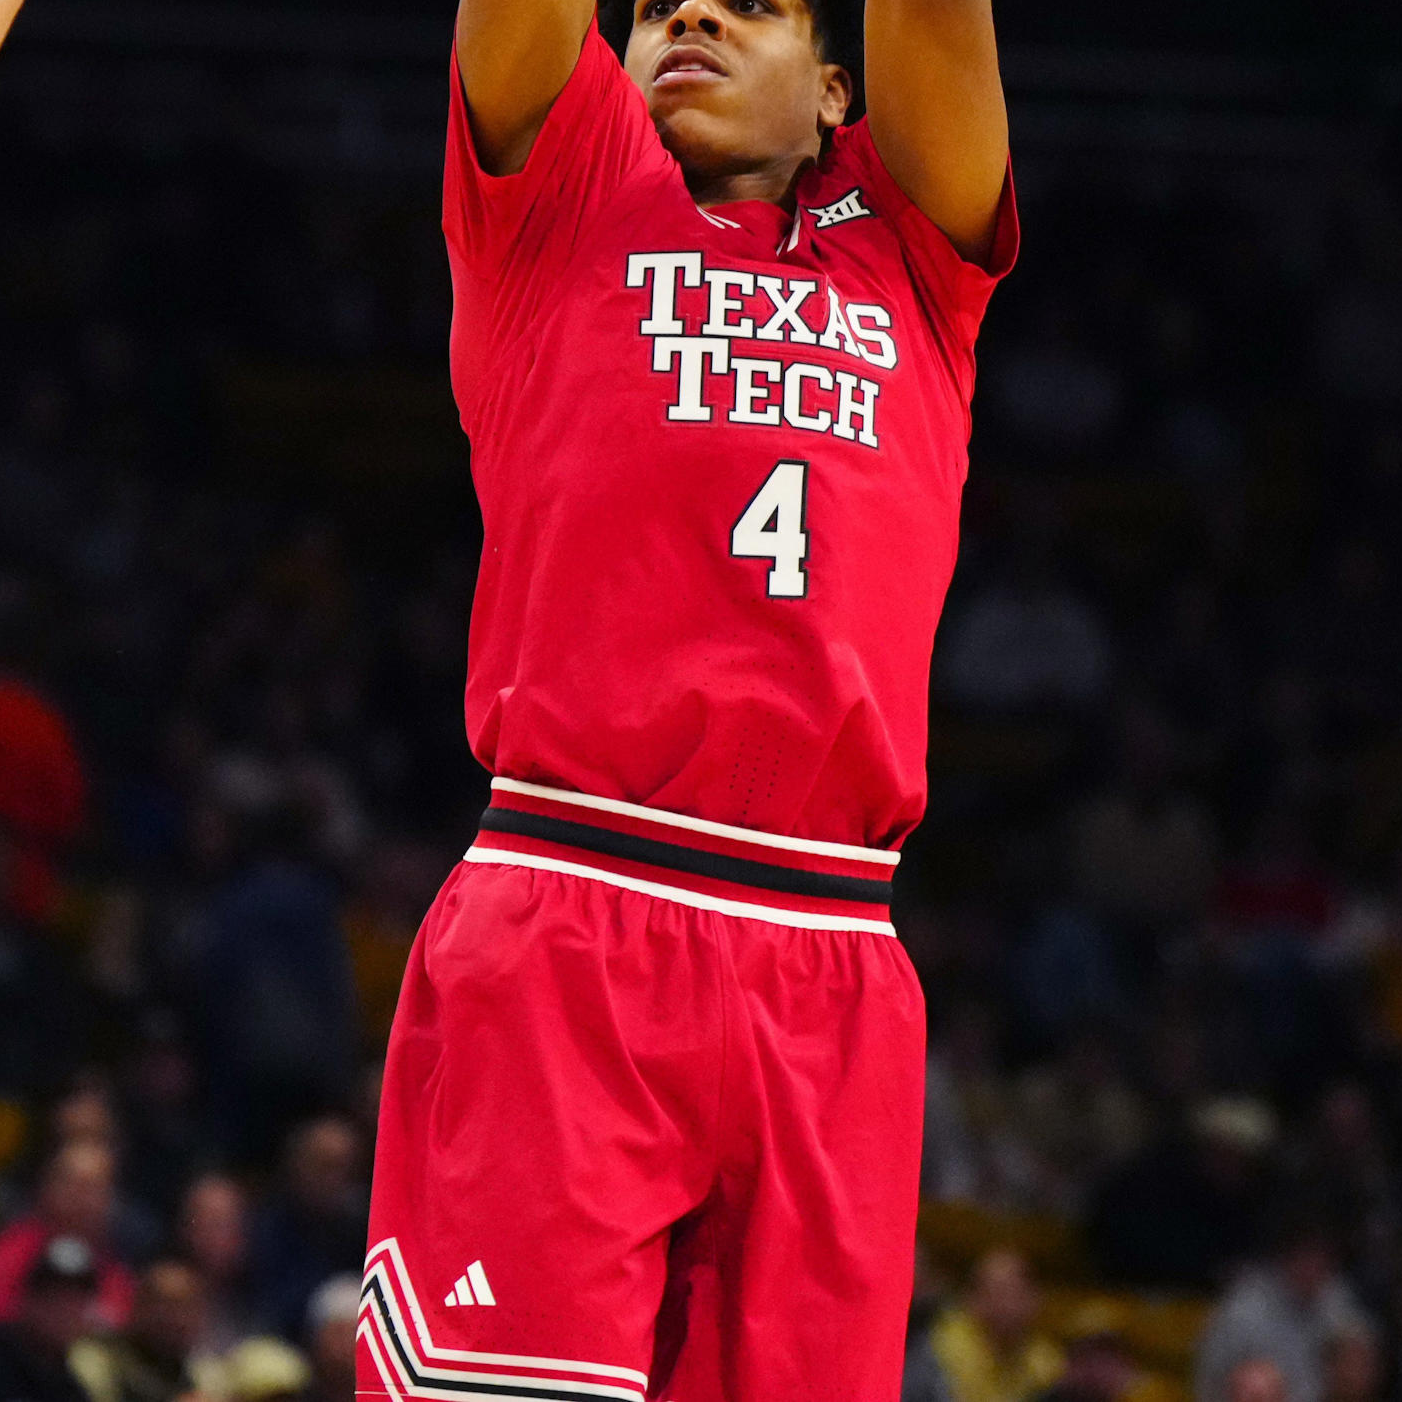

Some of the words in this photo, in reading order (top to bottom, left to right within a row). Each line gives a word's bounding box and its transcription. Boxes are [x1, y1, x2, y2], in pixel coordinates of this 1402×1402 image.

[626, 250, 899, 371] TEXAS
[651, 335, 881, 450] TECH
[729, 458, 810, 599] 4
